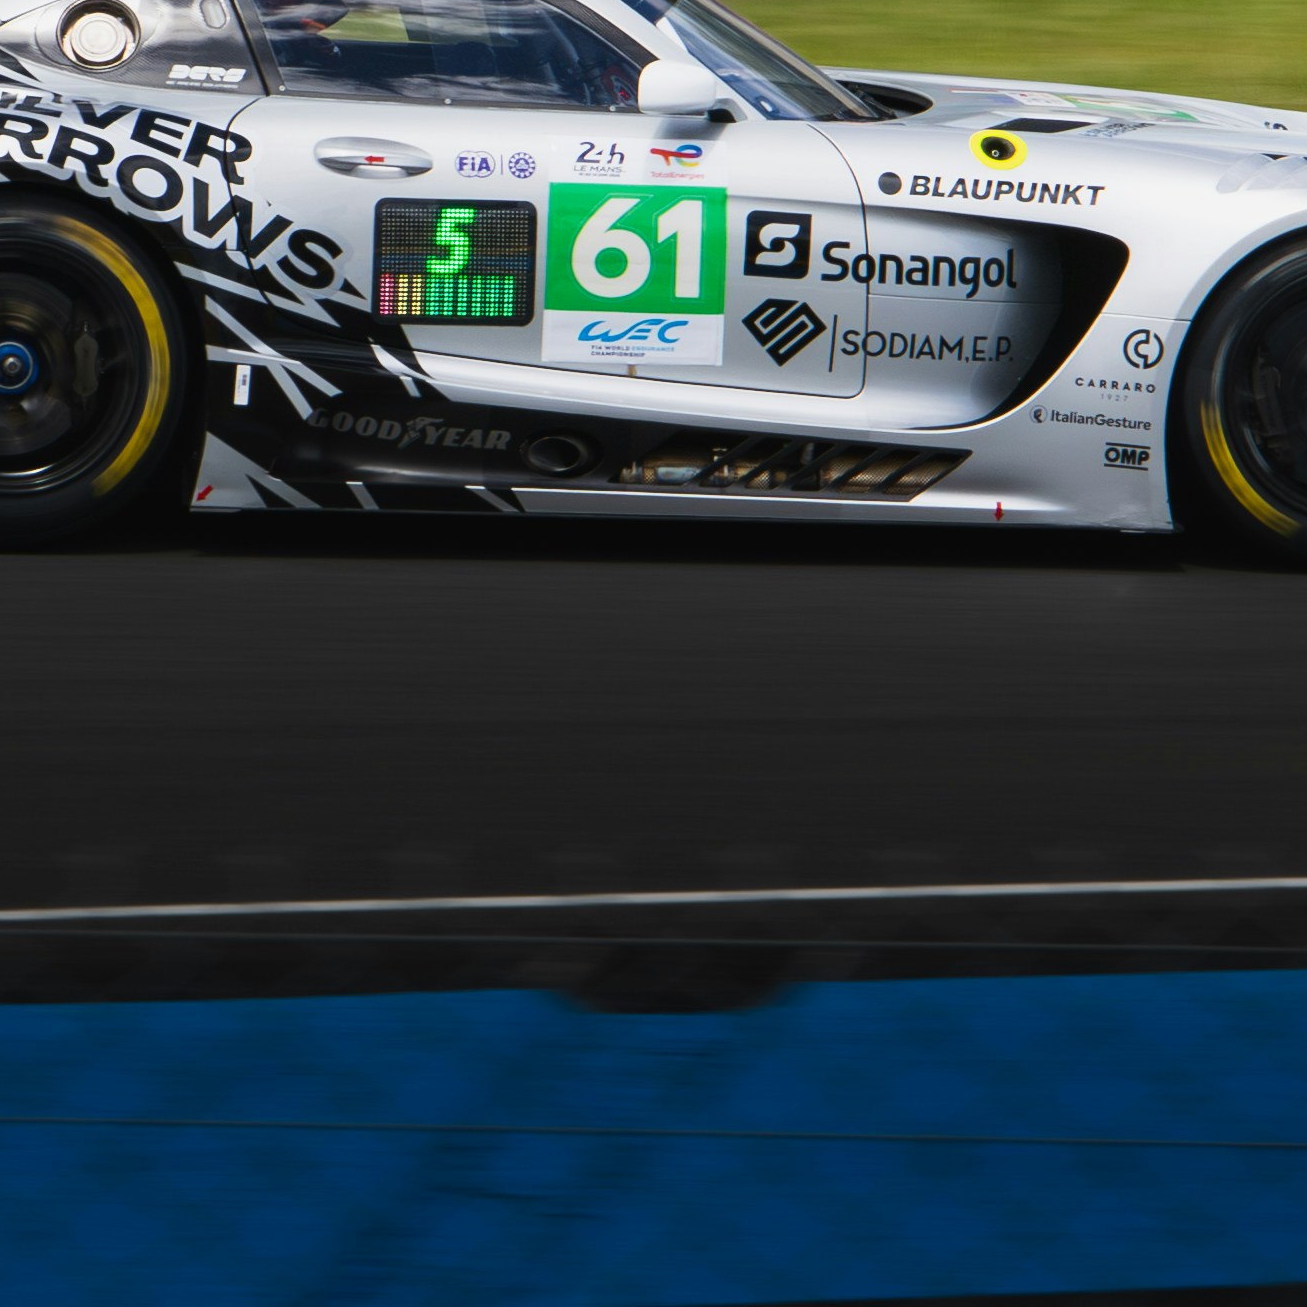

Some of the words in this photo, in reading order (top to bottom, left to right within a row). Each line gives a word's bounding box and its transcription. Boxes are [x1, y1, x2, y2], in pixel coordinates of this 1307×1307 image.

[590, 165, 623, 173] MANS
[909, 175, 1106, 205] BLAUPUNKT
[426, 208, 476, 273] 5
[571, 198, 705, 299] 61
[820, 241, 1017, 299] Sonangol
[578, 318, 690, 344] WEC
[1075, 377, 1156, 394] CARRARO
[1100, 393, 1129, 402] 1927
[1050, 409, 1152, 431] ItalianGesture
[1104, 447, 1150, 466] OMP
